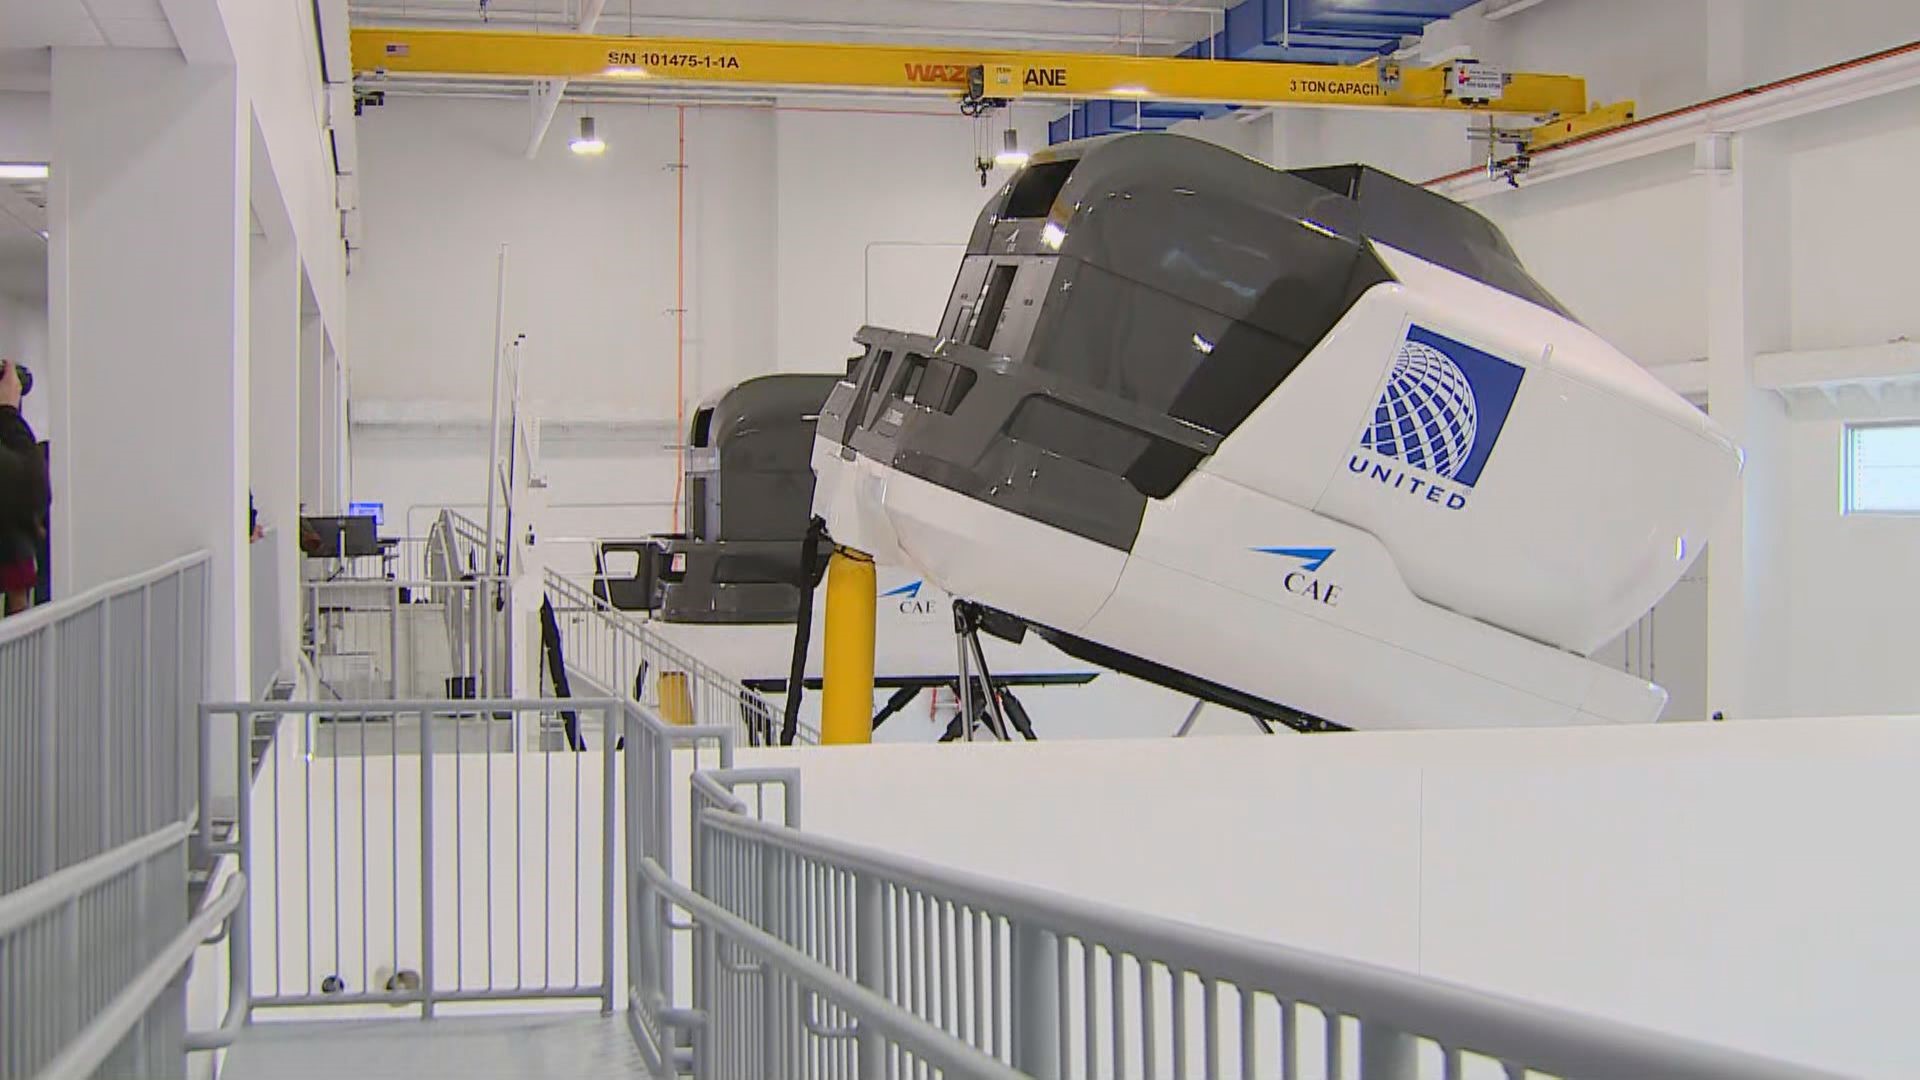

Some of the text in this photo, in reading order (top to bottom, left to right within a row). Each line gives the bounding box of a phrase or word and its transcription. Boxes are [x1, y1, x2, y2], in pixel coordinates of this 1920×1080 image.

[608, 51, 740, 69] S/N 101475-1-1A
[904, 63, 966, 83] WAZ
[1023, 68, 1067, 87] ANE
[1290, 80, 1297, 92] 3
[1301, 81, 1326, 93] TON
[1348, 455, 1467, 511] UNITED
[1283, 571, 1343, 607] CAE
[899, 600, 936, 615] CAE
